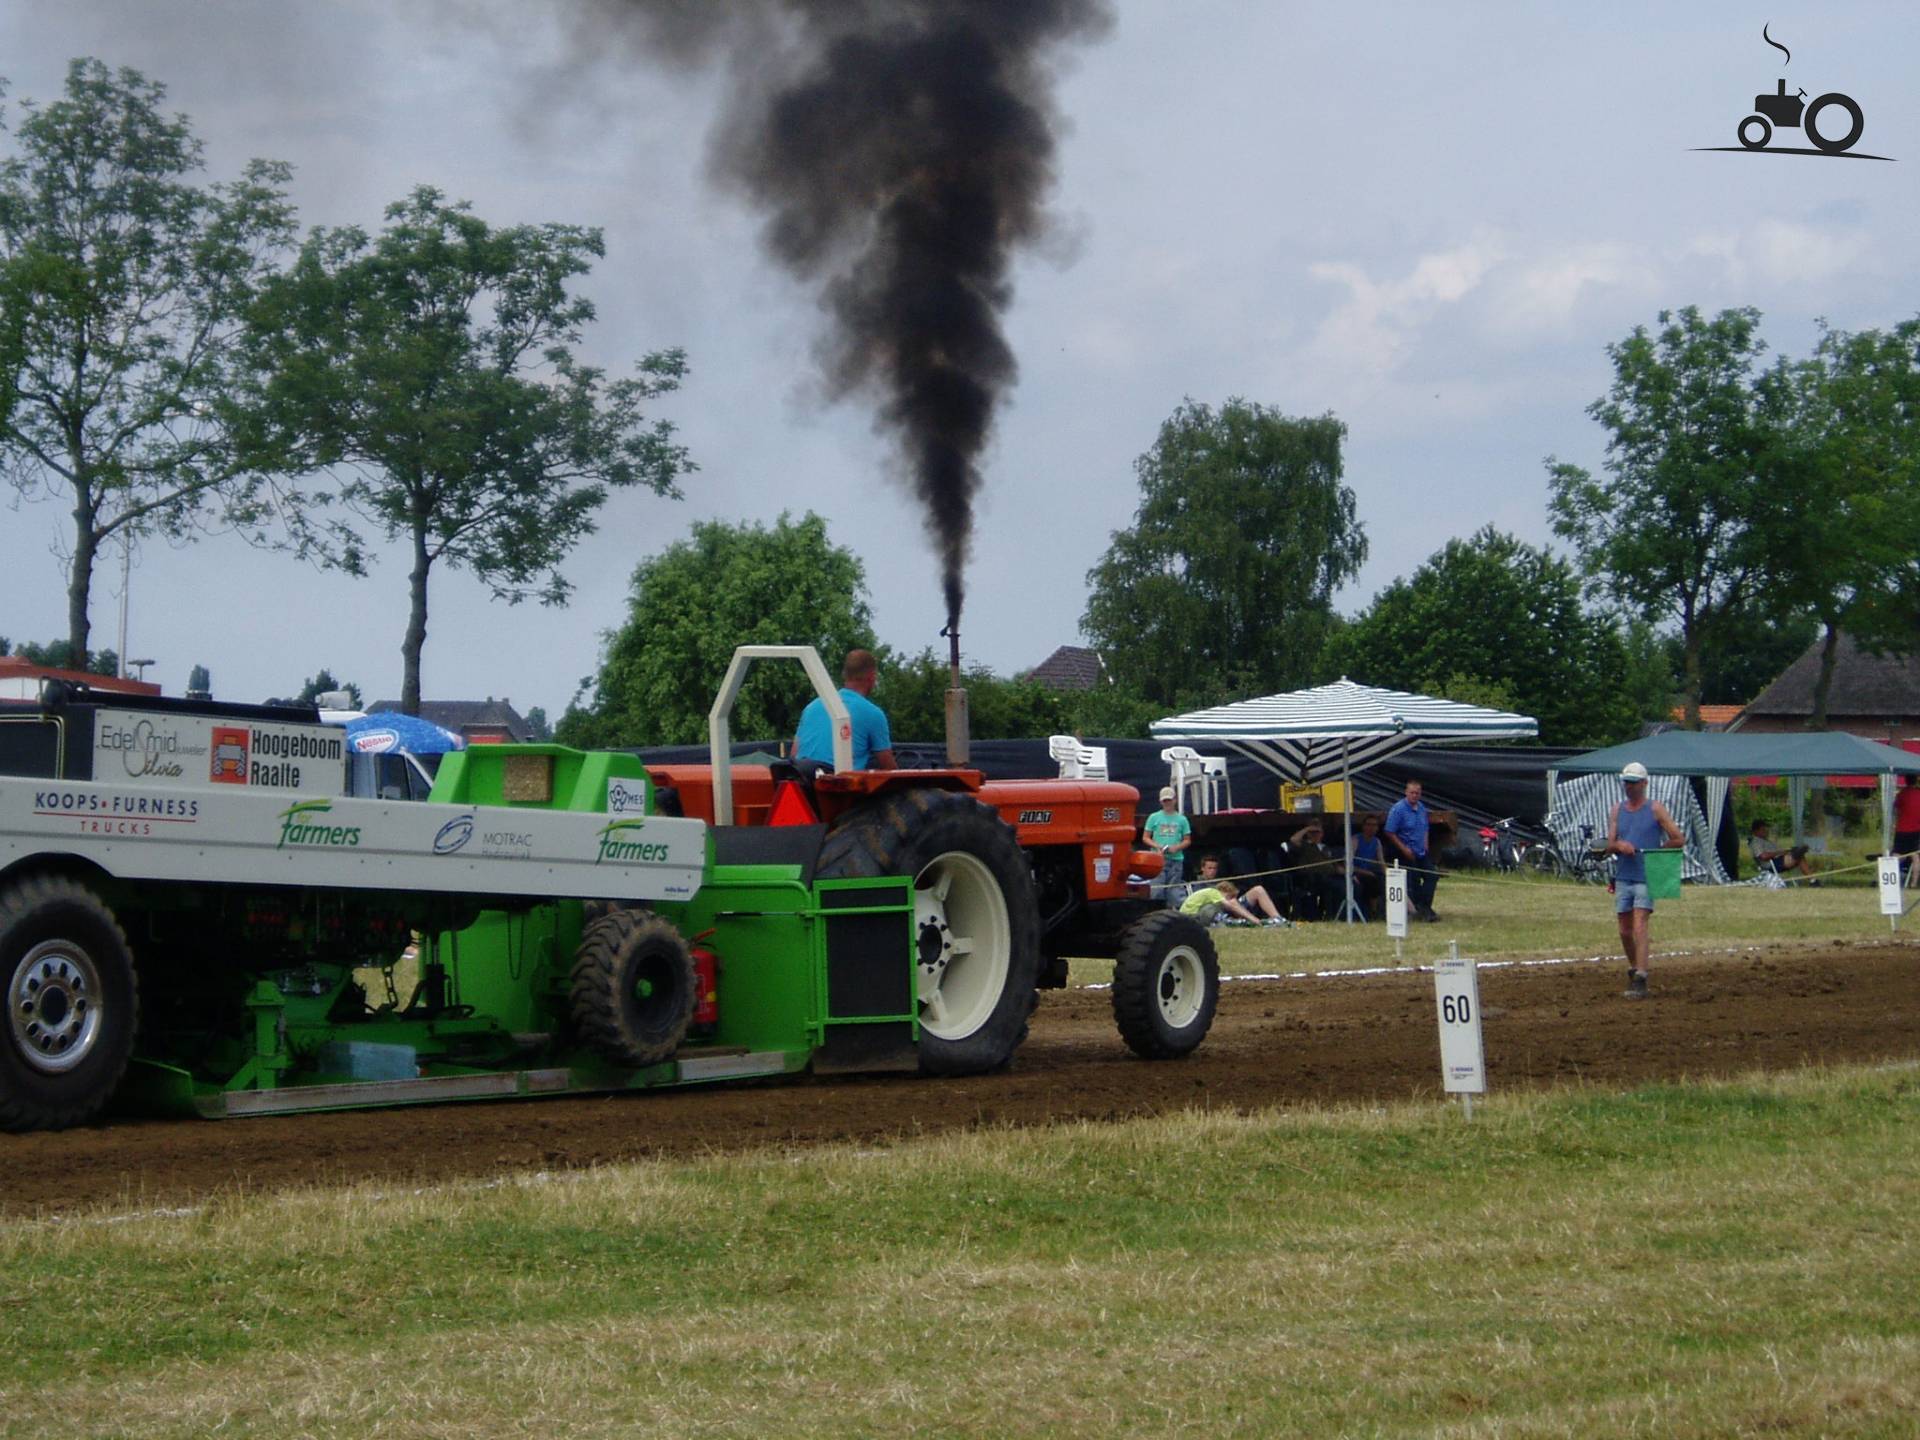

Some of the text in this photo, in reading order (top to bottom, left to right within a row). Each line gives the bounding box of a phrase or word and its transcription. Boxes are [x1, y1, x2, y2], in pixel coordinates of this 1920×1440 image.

[252, 730, 341, 760] Hoogeboom
[250, 761, 300, 788] Raalte
[35, 793, 198, 816] KOOPS FURNESS
[1020, 811, 1051, 823] FIAT
[81, 821, 150, 835] TRUCKS
[483, 832, 532, 847] MOTRAC
[1882, 872, 1897, 885] 90
[1389, 887, 1403, 902] 80
[1443, 994, 1470, 1024] 60
